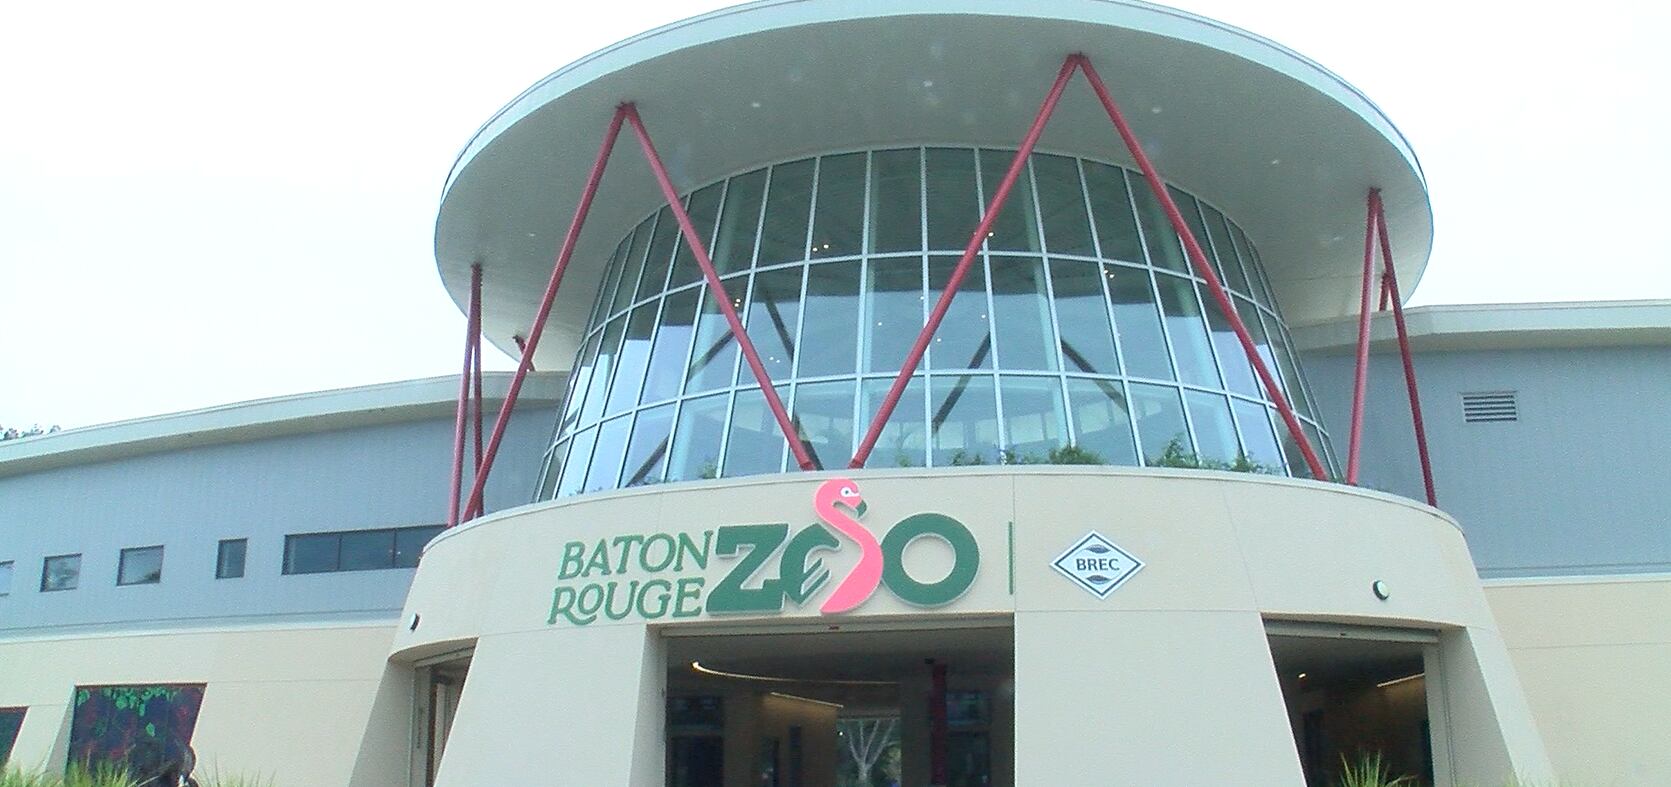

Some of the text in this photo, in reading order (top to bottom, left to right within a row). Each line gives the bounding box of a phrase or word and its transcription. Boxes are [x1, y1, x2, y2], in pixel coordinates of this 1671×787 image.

[557, 530, 714, 580] BATON
[705, 512, 981, 616] ZOO
[1075, 558, 1121, 571] BREC
[547, 577, 706, 625] ROUGE
